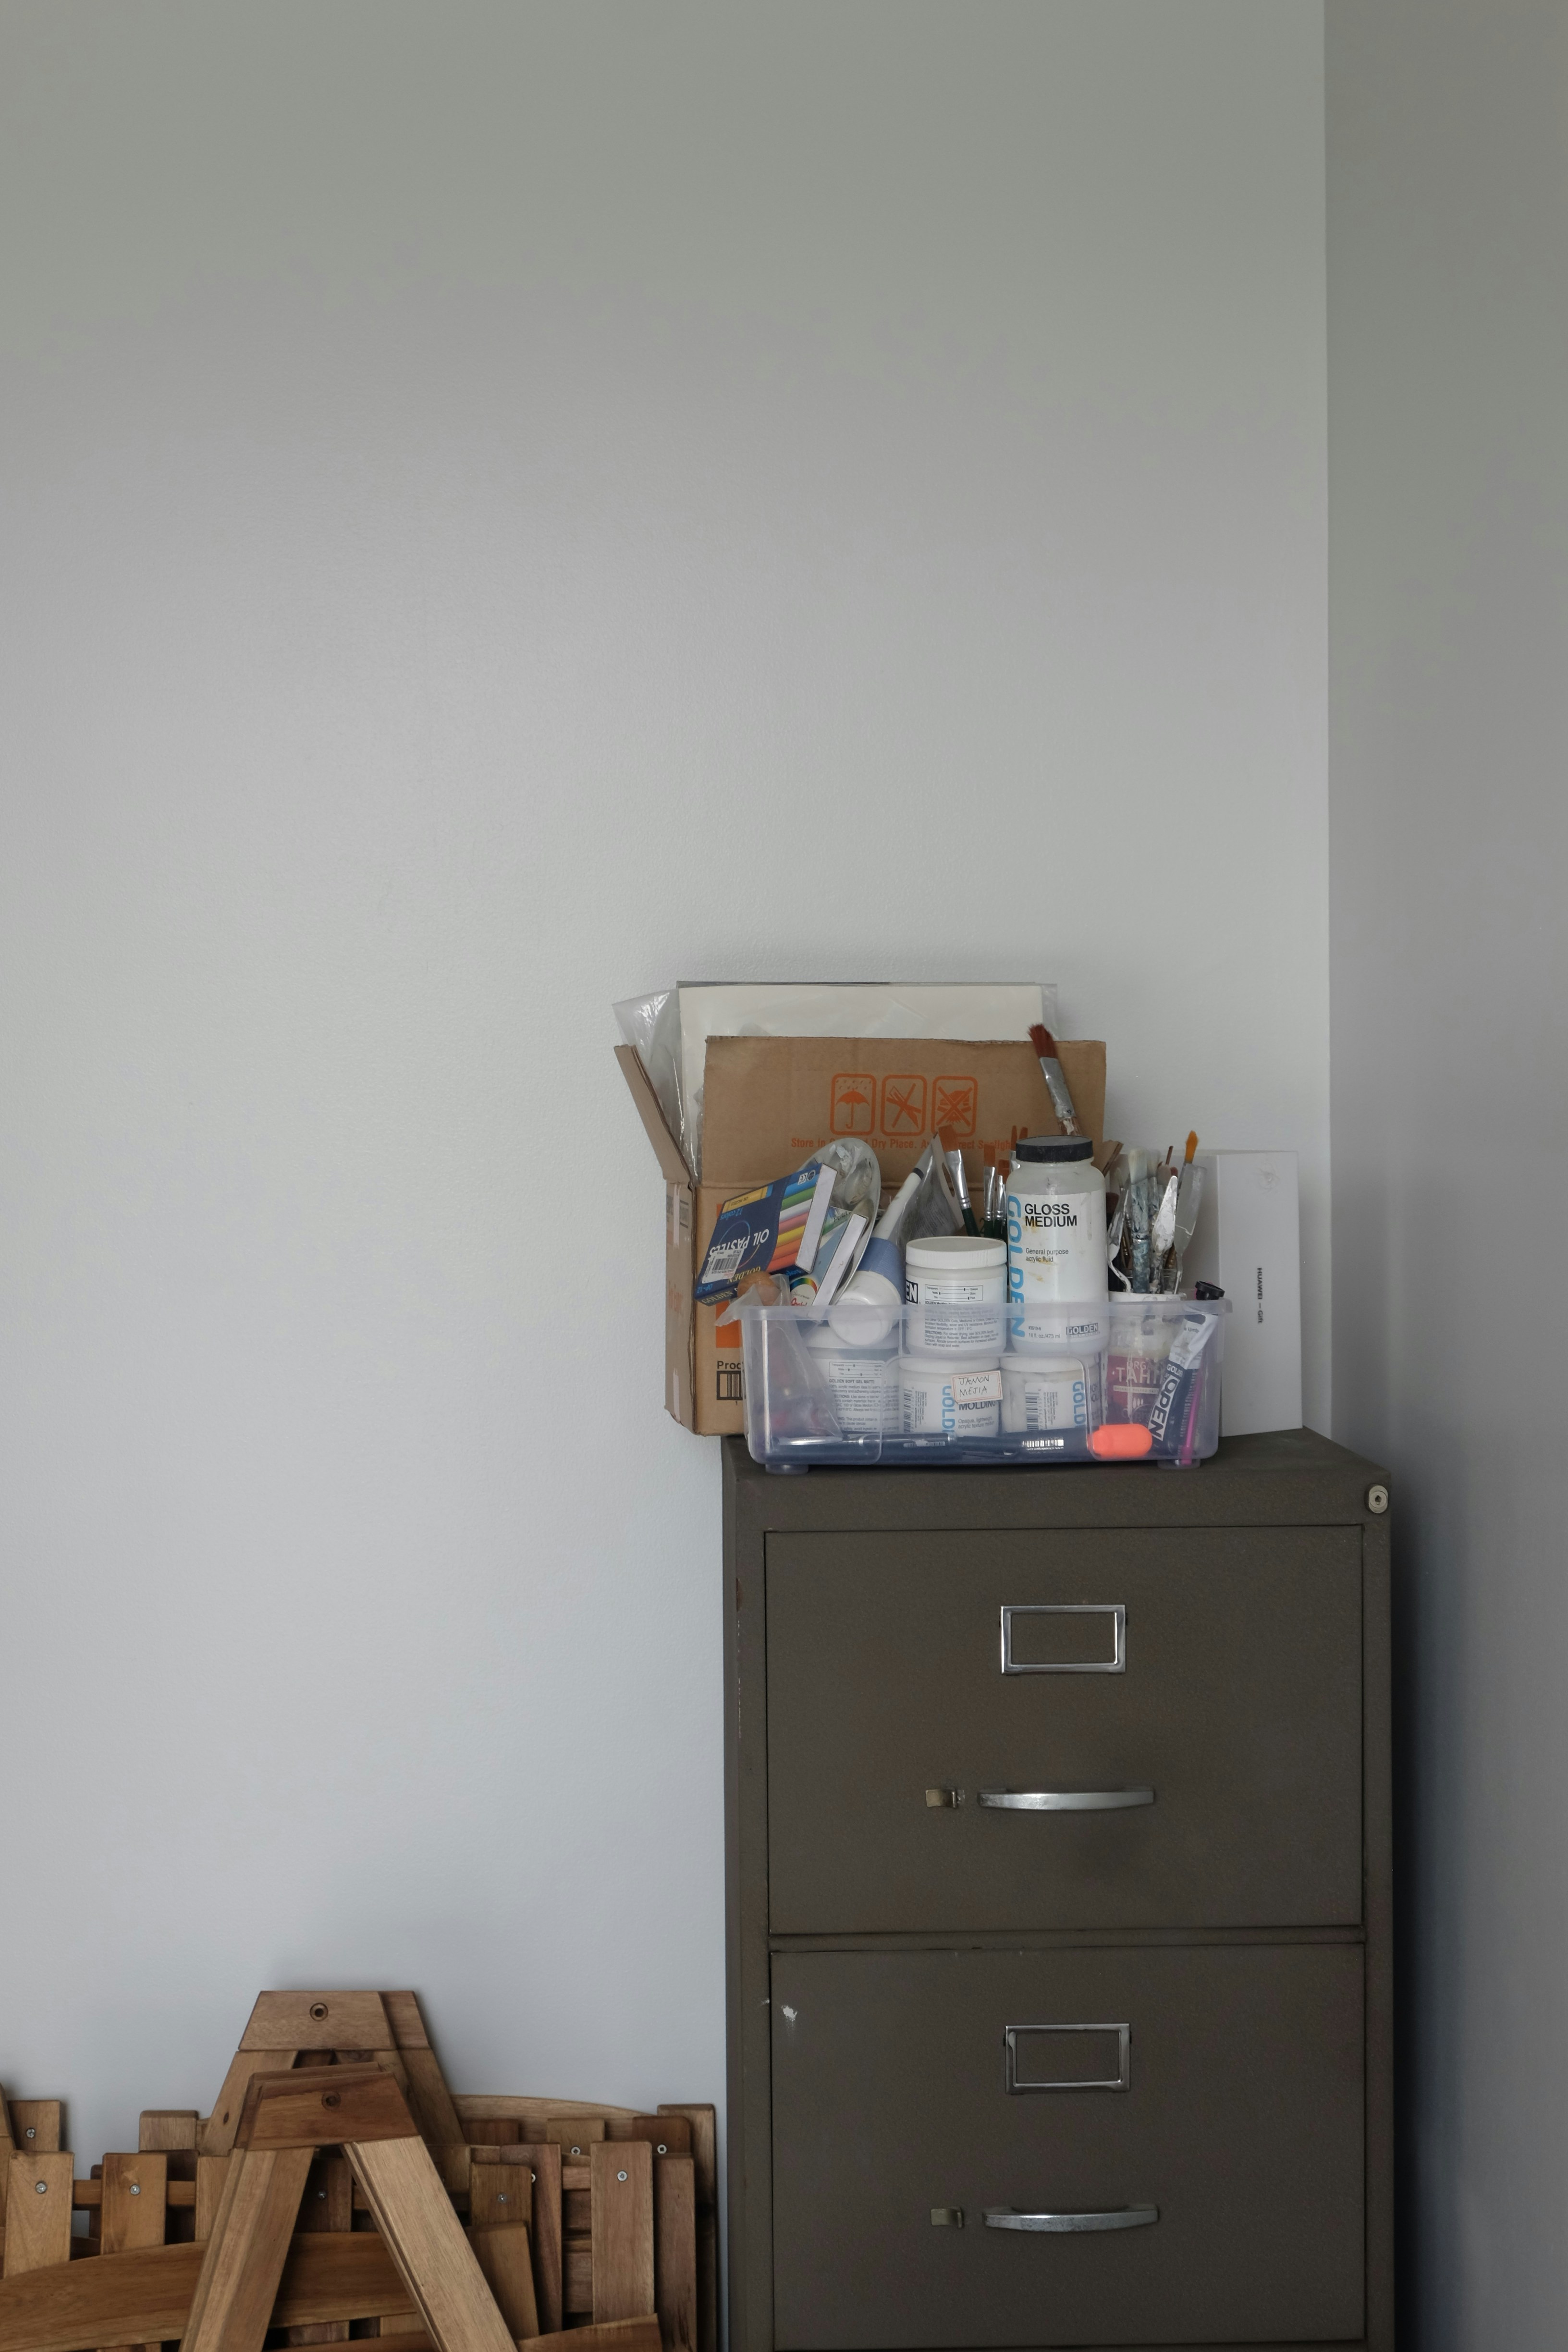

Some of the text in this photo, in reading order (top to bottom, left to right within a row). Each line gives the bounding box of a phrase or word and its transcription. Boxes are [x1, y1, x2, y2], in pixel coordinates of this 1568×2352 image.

[791, 1138, 814, 1148] Store
[872, 1138, 886, 1150] Dry
[890, 1138, 916, 1148] Place.
[1024, 1203, 1070, 1215] GLOSS
[1025, 1215, 1078, 1227] MEDIUM
[753, 1229, 770, 1247] OIL
[1008, 1195, 1025, 1337] GOLDEN
[701, 1290, 733, 1304] GOLDEN
[1067, 1323, 1098, 1335] GOLDEN
[1115, 1367, 1157, 1384] TAHI
[959, 1385, 988, 1397] MEJIA
[1151, 1378, 1177, 1439] OPEN
